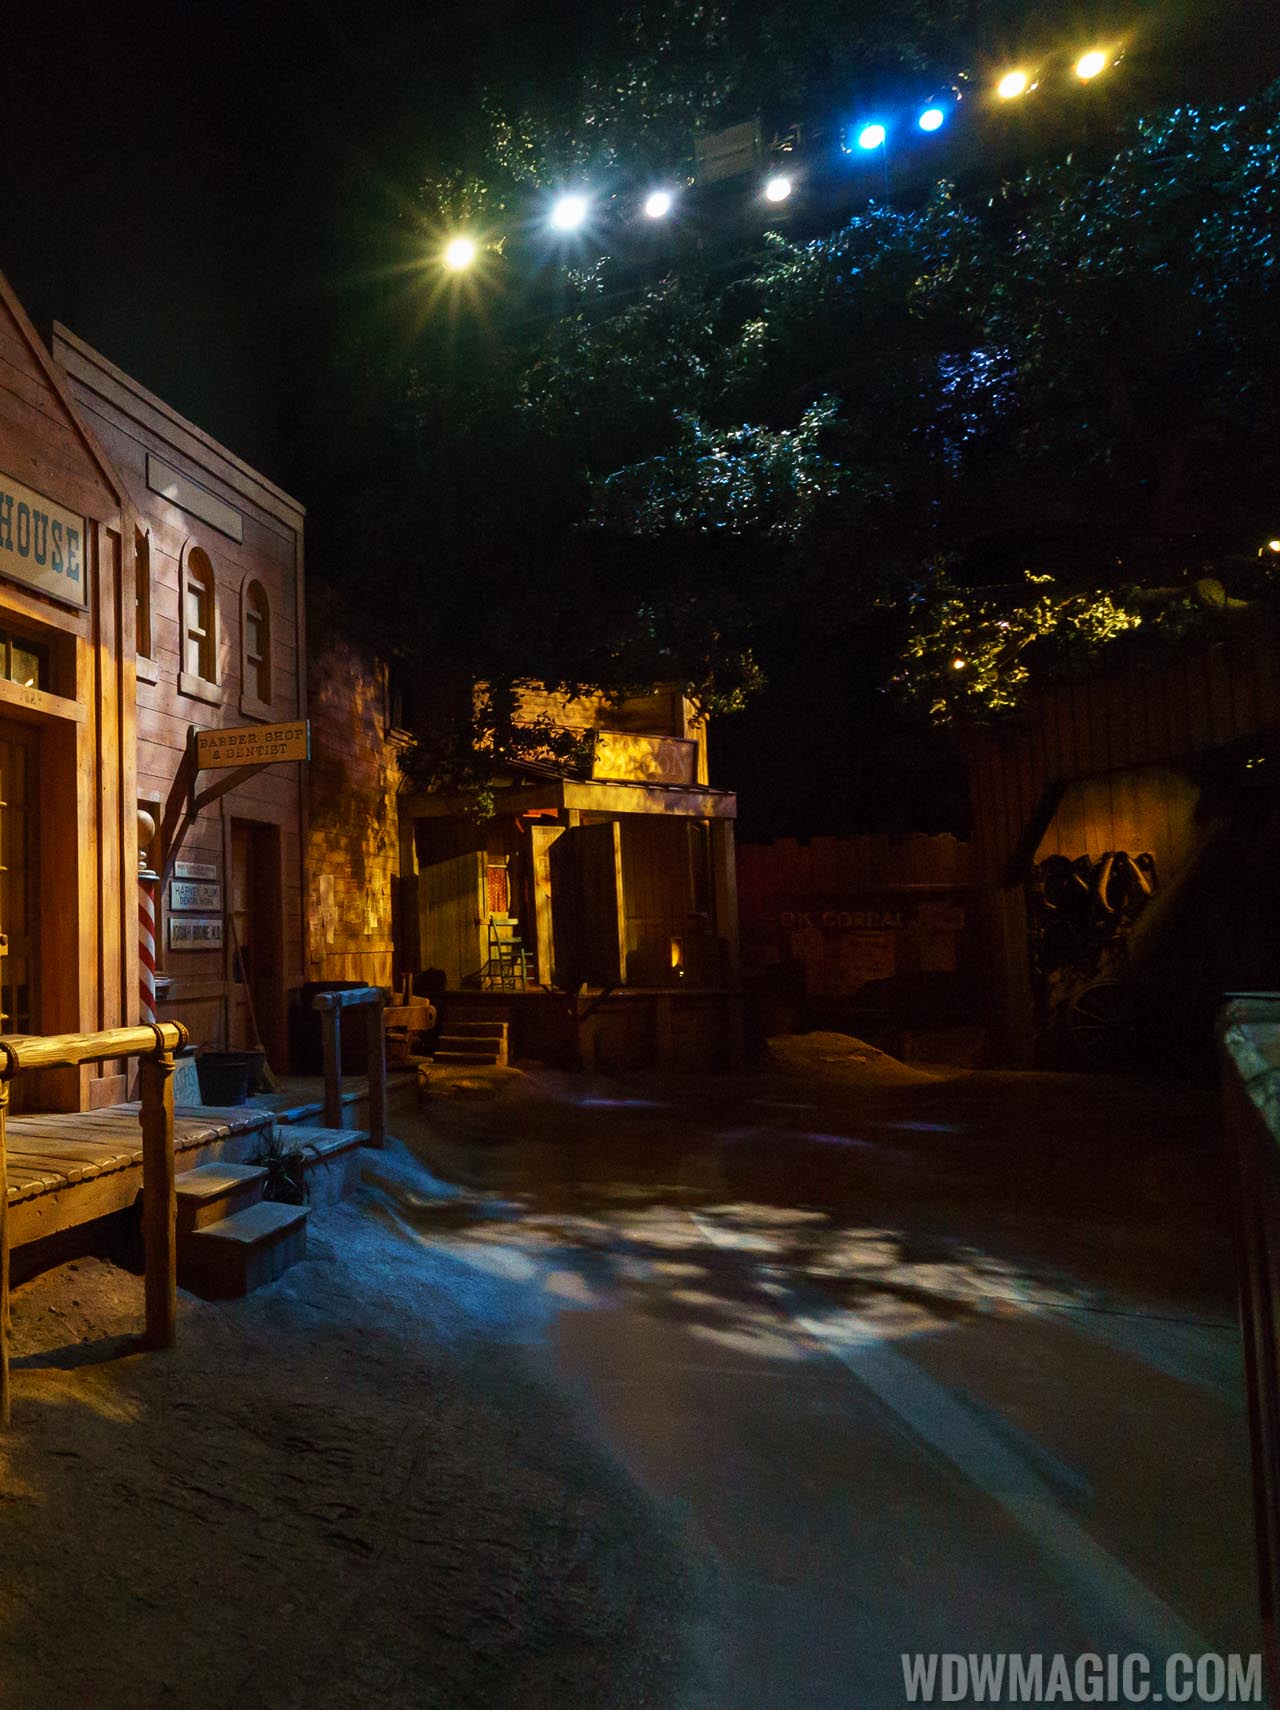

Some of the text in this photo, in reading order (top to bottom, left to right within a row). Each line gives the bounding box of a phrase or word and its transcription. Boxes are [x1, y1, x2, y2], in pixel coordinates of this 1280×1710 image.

[199, 728, 304, 749] BARBER SHOP
[226, 743, 288, 759] DENTIST
